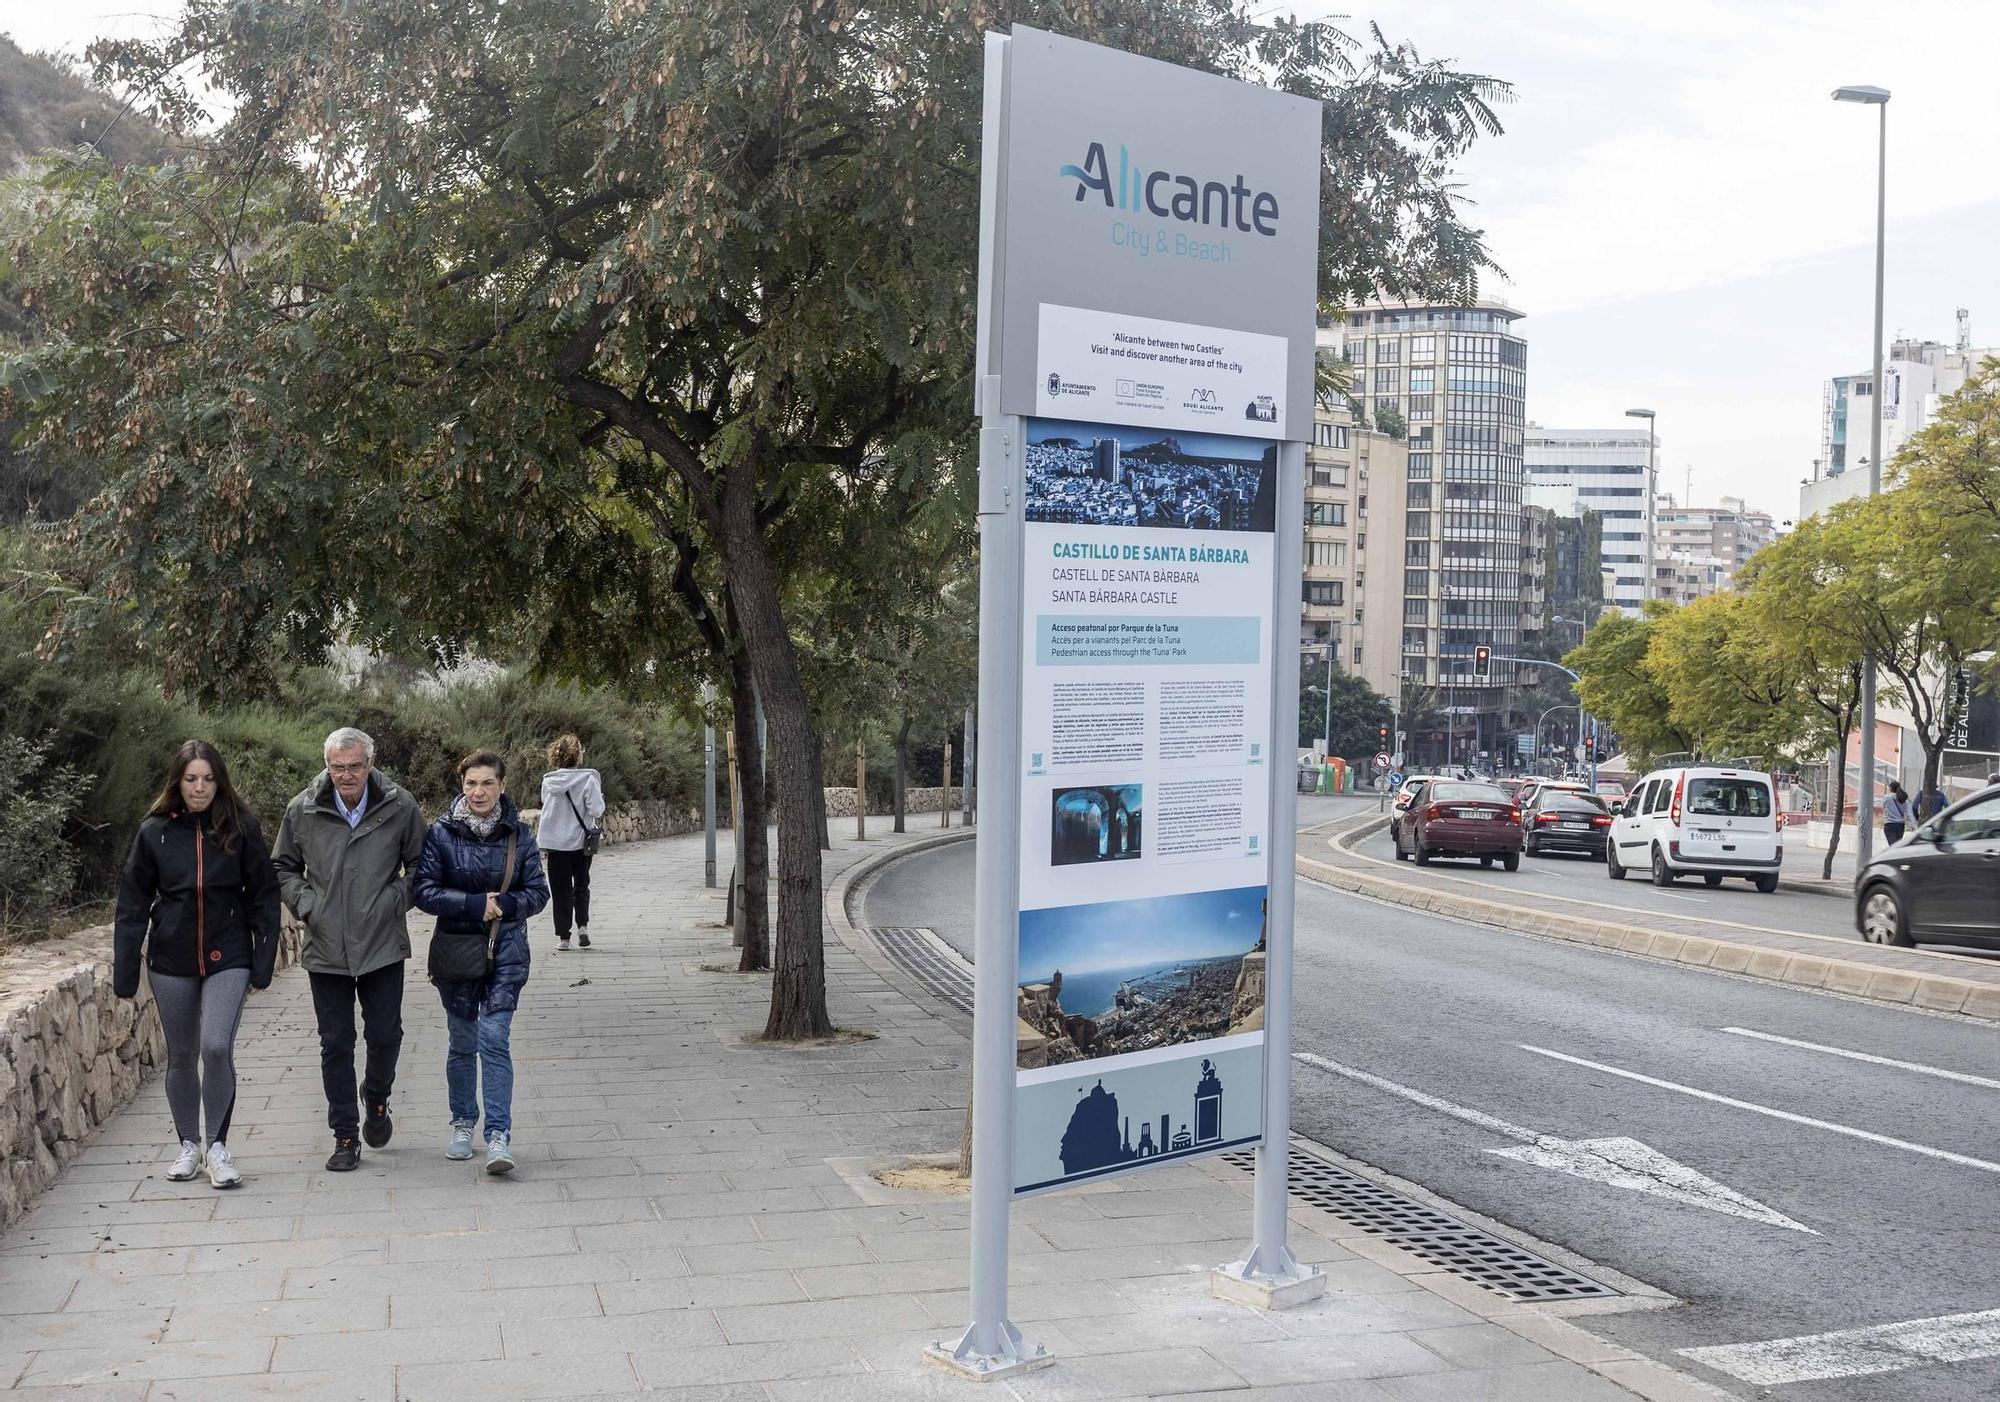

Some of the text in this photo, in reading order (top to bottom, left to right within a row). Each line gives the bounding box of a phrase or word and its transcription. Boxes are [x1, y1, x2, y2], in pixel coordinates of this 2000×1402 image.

[1060, 142, 1279, 236] Alicante
[1112, 222, 1232, 263] City & Beach
[1147, 337, 1179, 350] between
[1181, 342, 1195, 352] two
[1091, 344, 1243, 373] Visit and discover another area of the city
[1061, 383, 1096, 392] AYUNTAMIENTO
[1069, 388, 1090, 396] ALICANTE
[1053, 543, 1249, 563] CASTILLO DE SANTA BÁRBARA
[1053, 568, 1099, 580] CASTELL
[1102, 569, 1115, 581] DE
[1118, 569, 1150, 582] SANTA
[1052, 588, 1178, 604] SANTA BÁRBARA CASTLE
[1052, 624, 1179, 633] Acceso peatonal por Parque de la Tuna
[1073, 637, 1083, 645] per
[1121, 636, 1131, 646] pel
[1132, 636, 1147, 644] Parc
[1147, 636, 1156, 644] de
[1157, 636, 1163, 644] la
[1164, 636, 1181, 644] Tuna
[1052, 648, 1088, 656] Pedestrian
[1112, 648, 1139, 658] through
[1140, 648, 1151, 656] the
[1172, 648, 1187, 656] Park
[1957, 729, 1968, 748] DE
[1695, 833, 1712, 841] 5672
